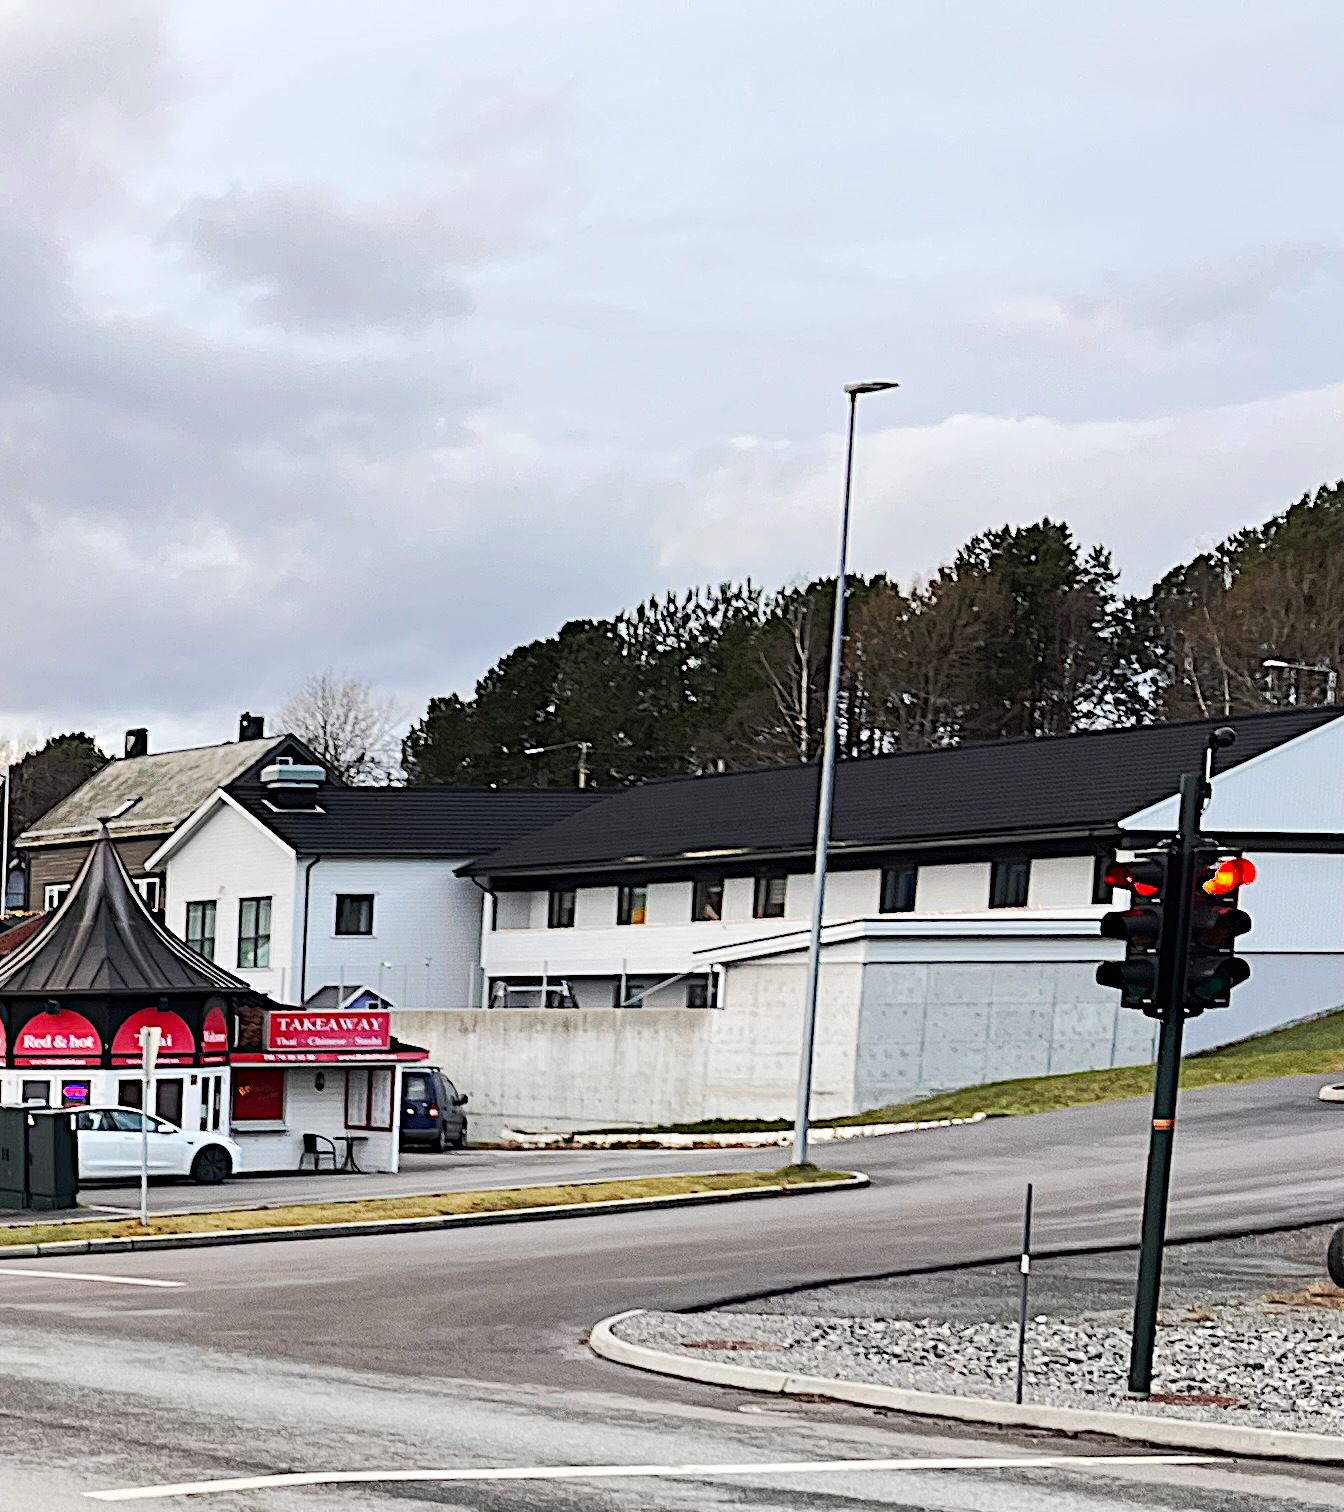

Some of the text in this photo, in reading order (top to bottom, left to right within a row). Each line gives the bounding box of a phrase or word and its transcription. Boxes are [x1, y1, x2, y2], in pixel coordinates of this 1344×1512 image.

[276, 1017, 384, 1032] TAKEAWAY
[23, 1034, 94, 1049] Red & hot
